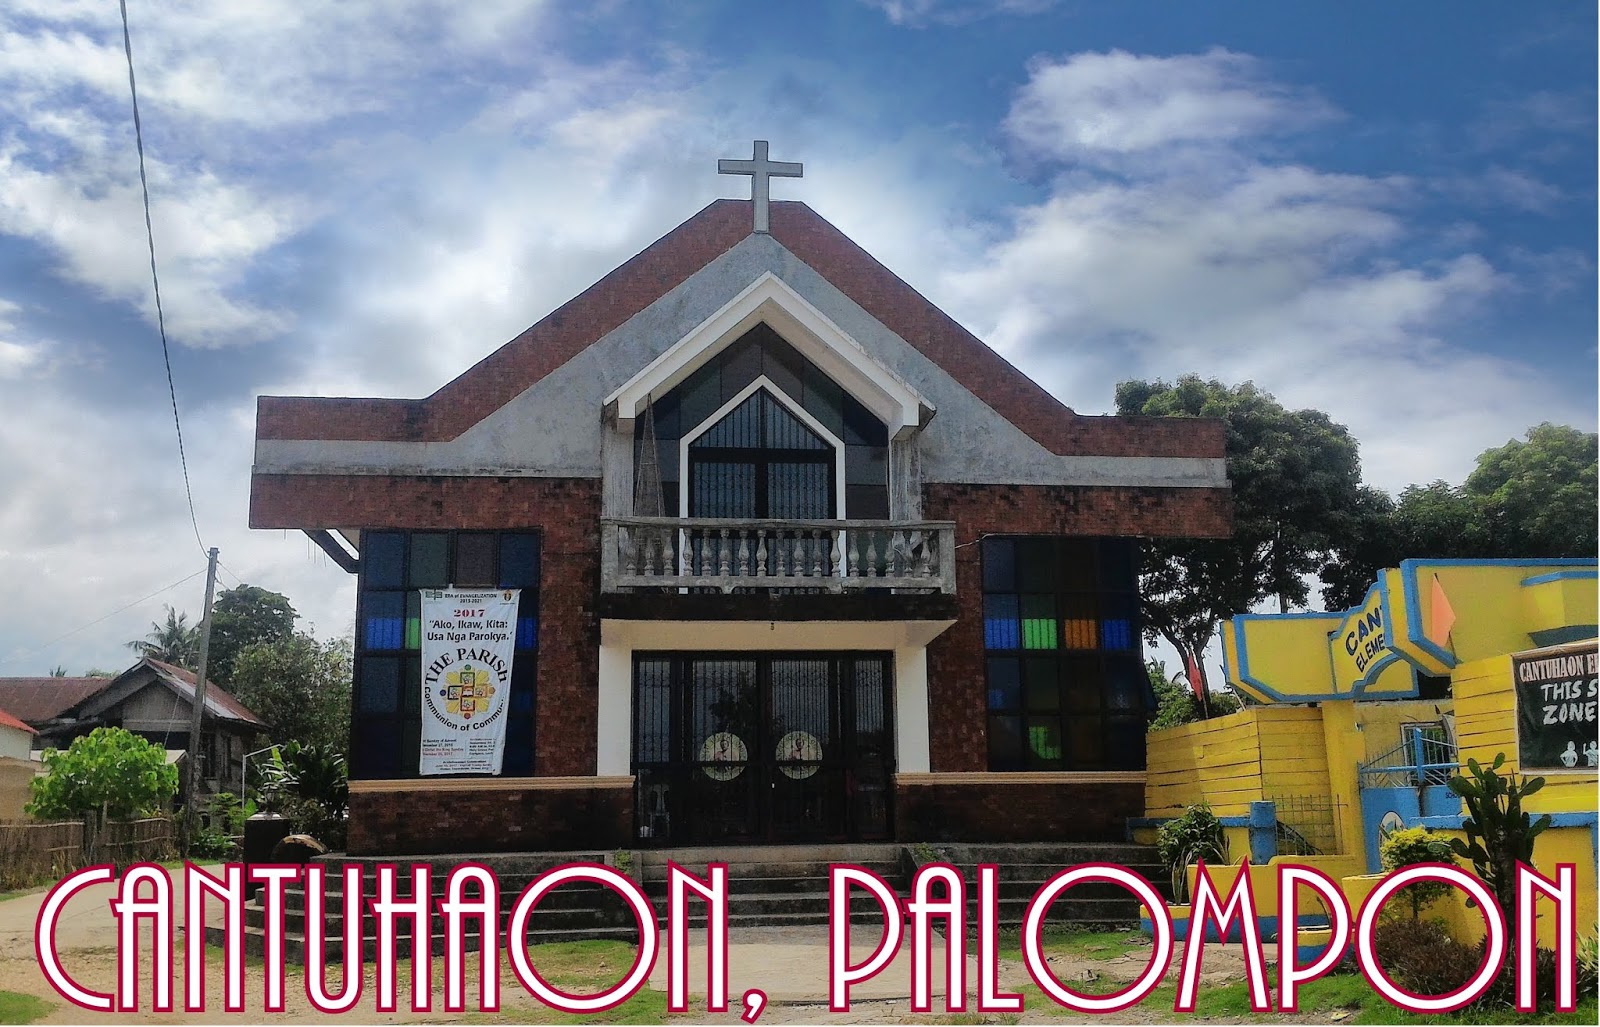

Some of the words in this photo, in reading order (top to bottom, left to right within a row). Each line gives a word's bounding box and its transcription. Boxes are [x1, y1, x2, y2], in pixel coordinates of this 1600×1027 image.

[453, 609, 485, 617] 2017
[458, 620, 483, 630] Ikaw,
[486, 620, 508, 629] Kita:
[427, 632, 444, 641] Usa
[446, 632, 466, 643] Nga
[1345, 605, 1383, 656] CAN
[1356, 633, 1386, 673] ELEME
[425, 652, 454, 684] THE
[456, 648, 508, 683] PARISH
[1519, 655, 1584, 682] CANTUHAON
[1540, 680, 1583, 702] THIS
[424, 686, 458, 730] Communion
[1542, 701, 1598, 725] ZONE
